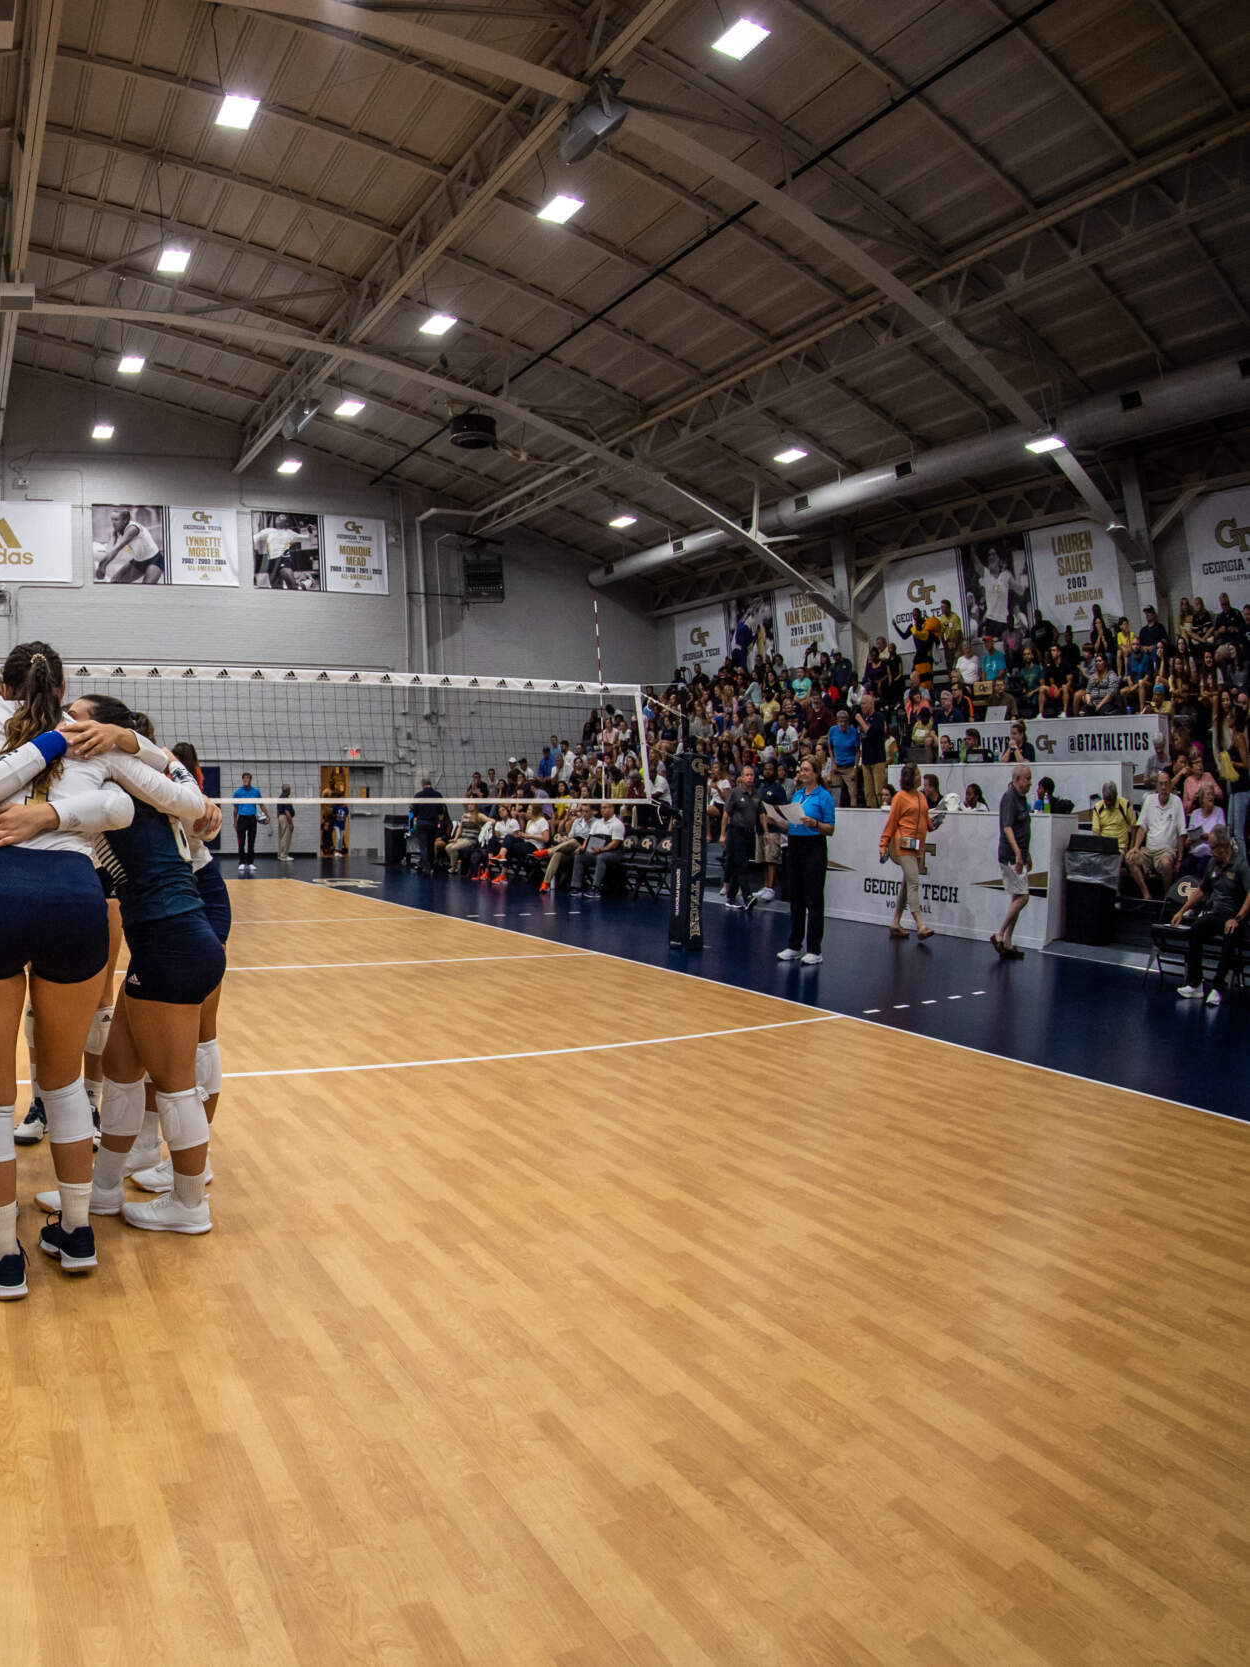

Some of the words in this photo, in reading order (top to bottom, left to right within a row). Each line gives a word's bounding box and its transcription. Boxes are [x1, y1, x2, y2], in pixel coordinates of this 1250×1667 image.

[192, 511, 213, 524] GT
[344, 521, 363, 534] GT
[185, 536, 222, 547] LYNNETTE
[339, 545, 372, 557] MONIQUE
[1052, 531, 1093, 556] LAUREN
[188, 547, 220, 557] MOSTER
[346, 556, 367, 567] MEAD
[1056, 553, 1093, 576] SAUER
[1202, 559, 1245, 575] GEORGIA
[907, 579, 936, 605] GT
[1067, 575, 1087, 590] 2003
[1054, 588, 1104, 606] ALL-AMERICAN
[690, 626, 709, 647] GT
[1035, 734, 1057, 754] GT
[1068, 732, 1149, 753] @GTATHLETICS
[691, 785, 704, 877] GEORGIA
[922, 884, 959, 904] TECH
[689, 881, 702, 937] TECH
